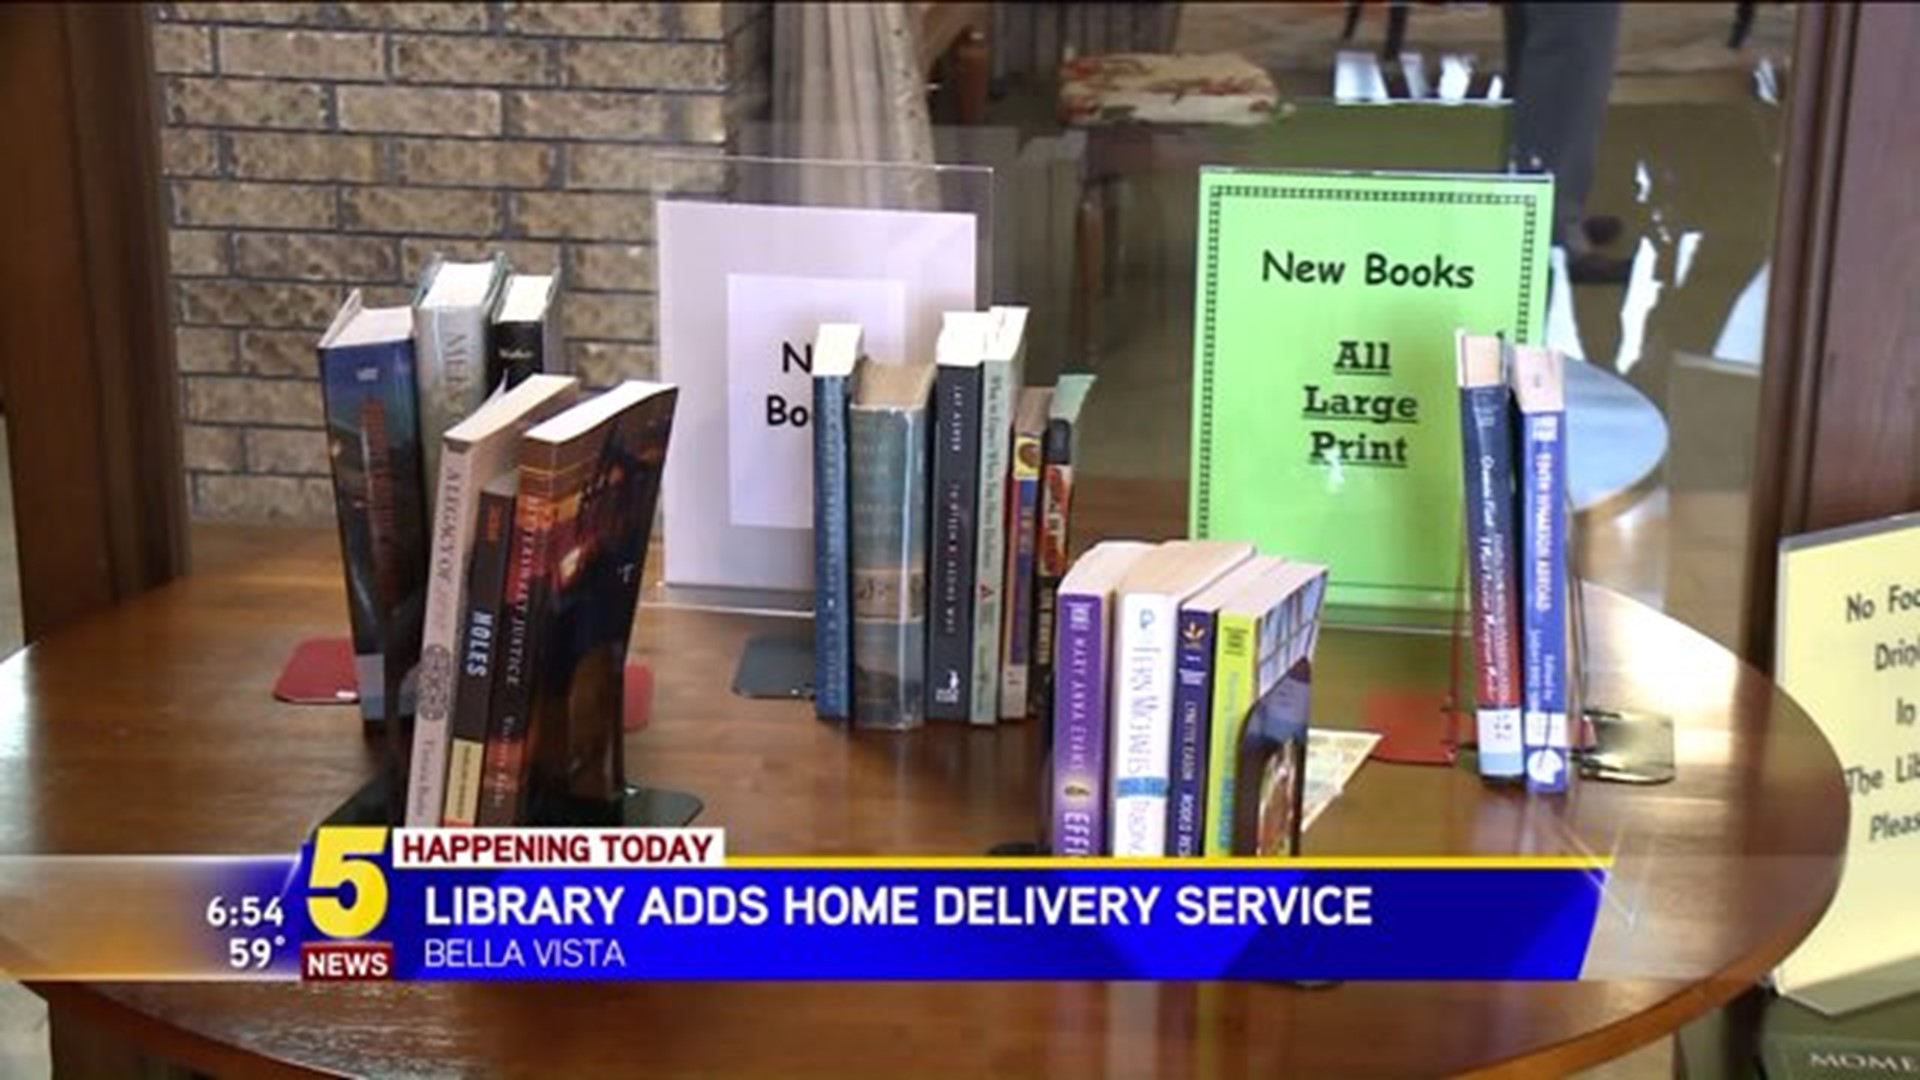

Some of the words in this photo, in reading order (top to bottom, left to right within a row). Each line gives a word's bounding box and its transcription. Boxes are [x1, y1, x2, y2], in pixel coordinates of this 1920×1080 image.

[1262, 249, 1345, 284] New
[1365, 252, 1475, 288] Books
[1334, 341, 1391, 371] All
[1303, 385, 1419, 424] Large
[1309, 431, 1407, 466] Print
[1846, 592, 1876, 624] No
[466, 610, 493, 677] HOLES
[505, 616, 526, 686] JUSTICE
[1070, 637, 1088, 675] MARY
[1070, 680, 1088, 725] ANNA
[1069, 726, 1088, 772] EVANS
[1846, 765, 1884, 795] The
